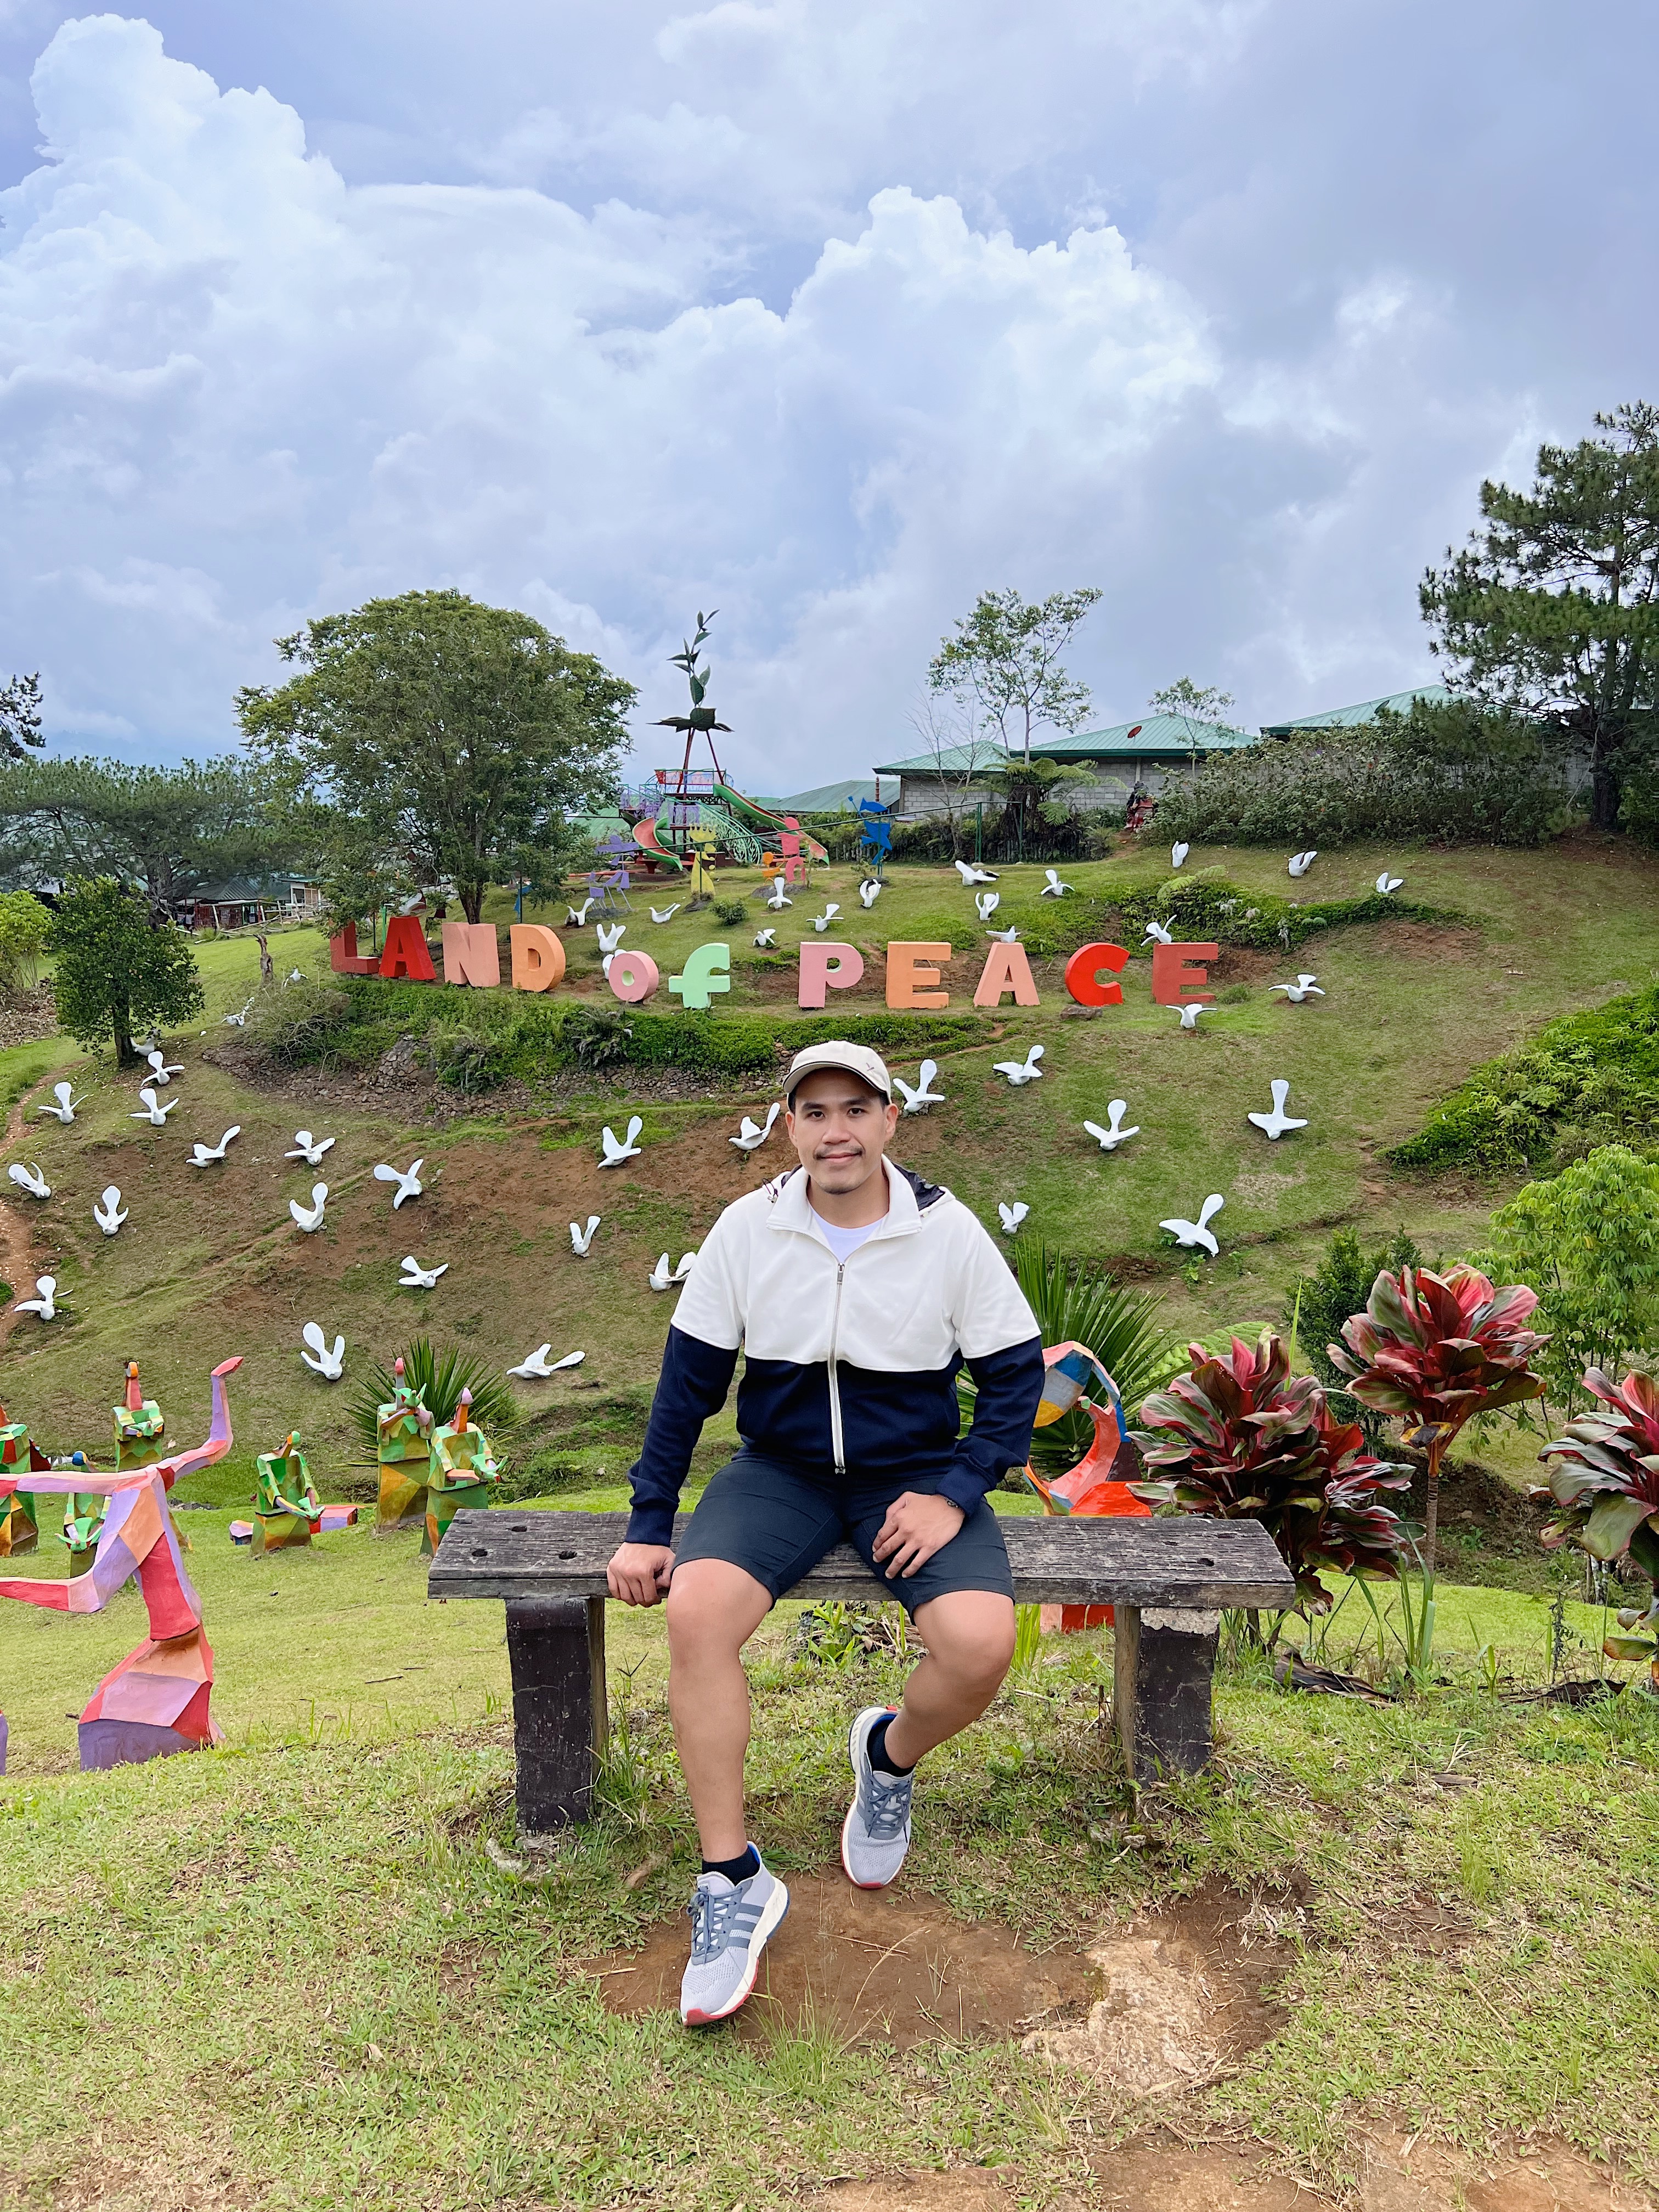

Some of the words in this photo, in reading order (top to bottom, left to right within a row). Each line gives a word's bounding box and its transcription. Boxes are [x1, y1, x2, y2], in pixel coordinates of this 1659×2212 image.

[330, 916, 565, 992] LAND
[608, 943, 730, 1009] of
[798, 941, 1218, 1009] PEACE
